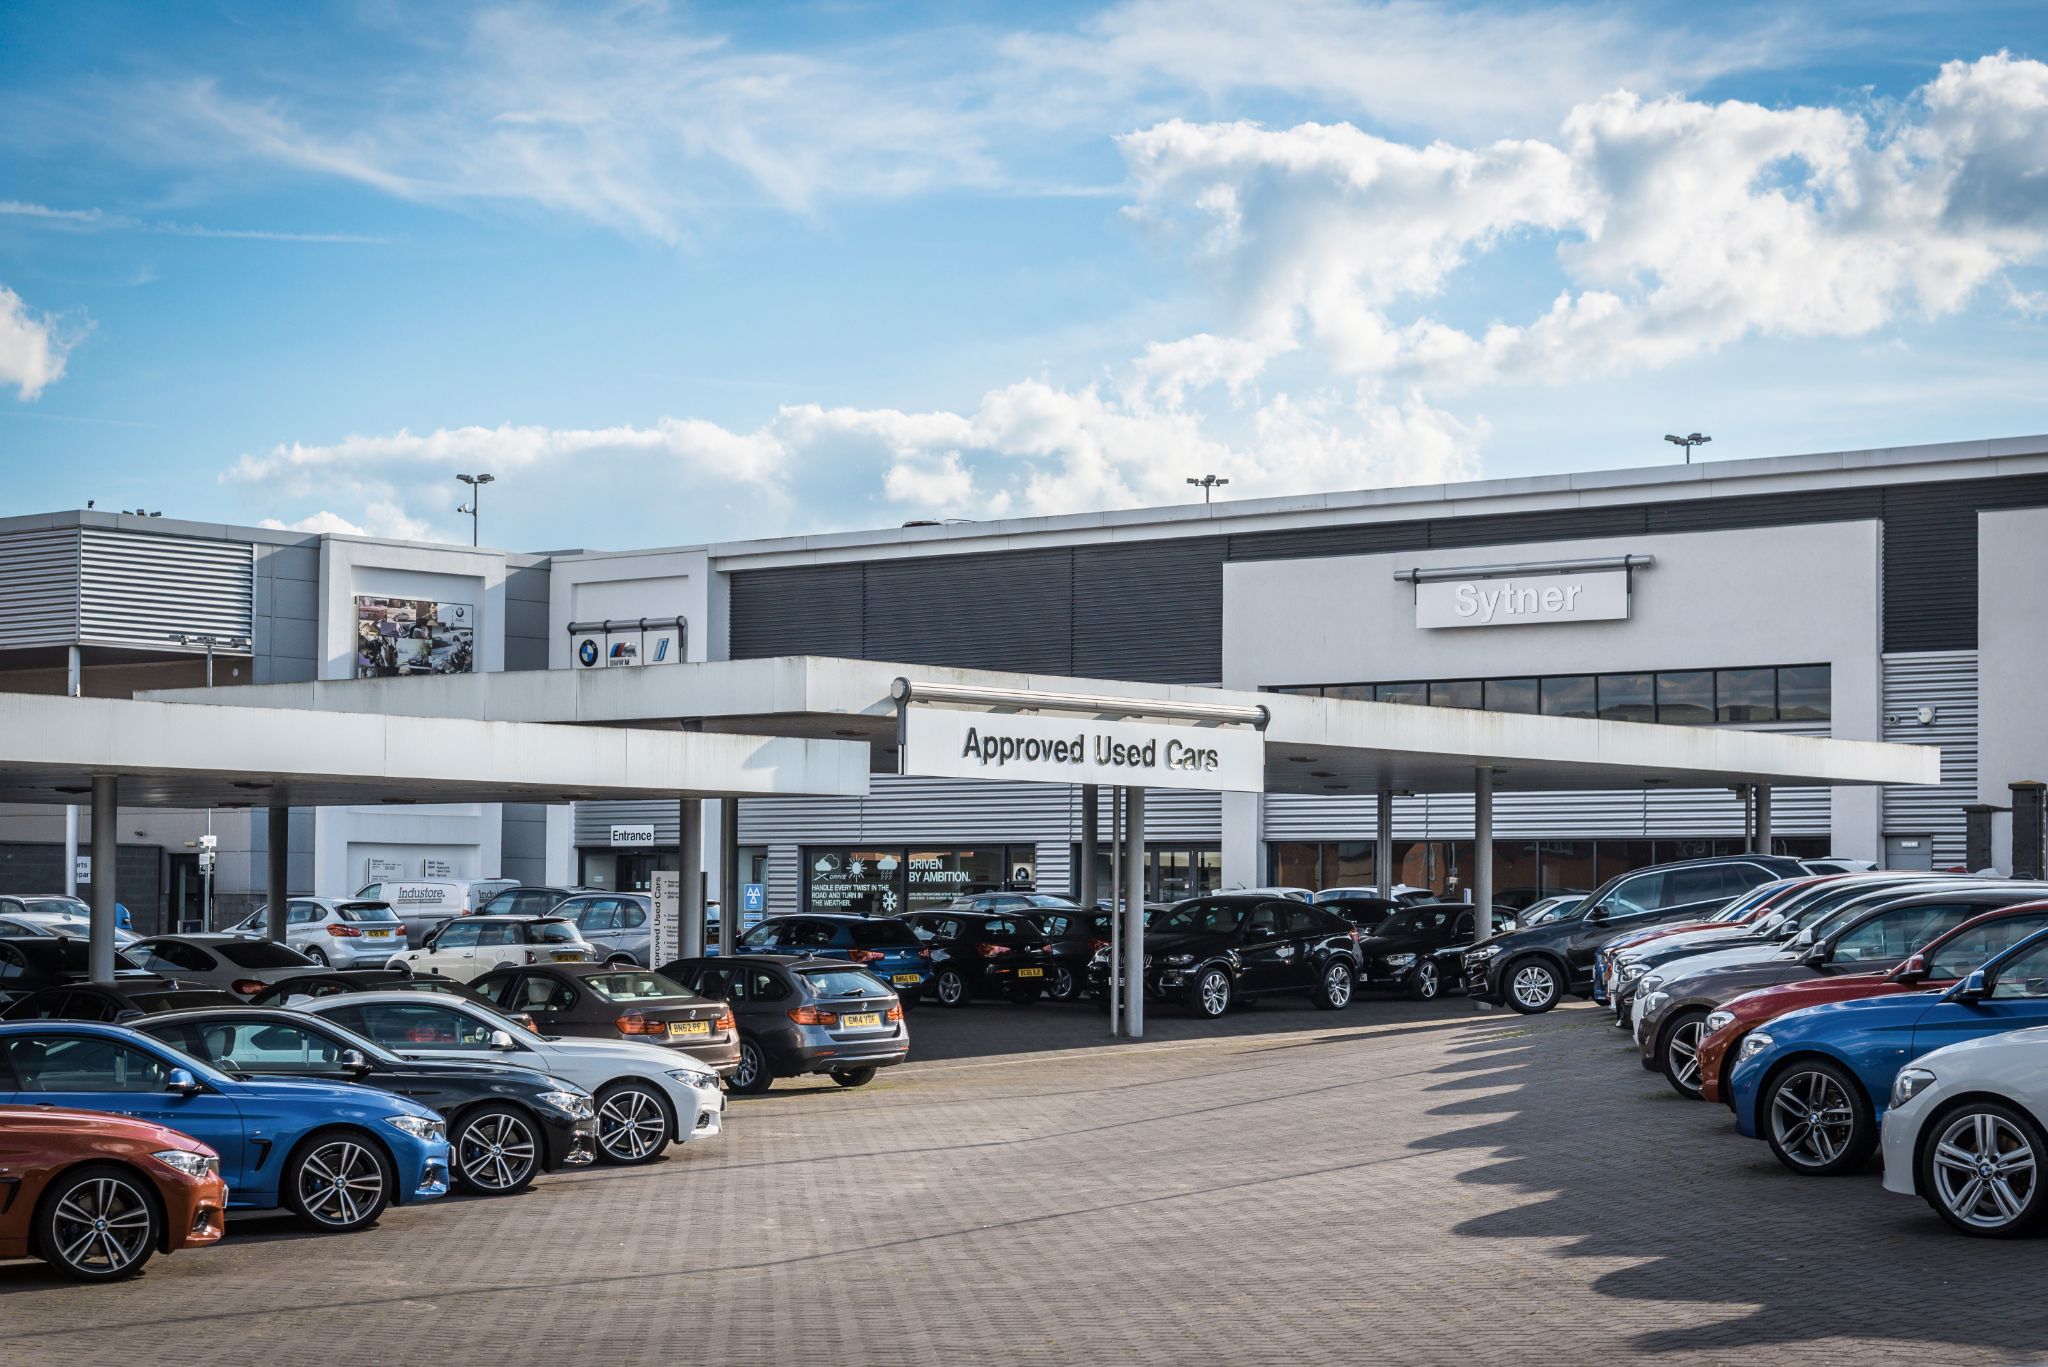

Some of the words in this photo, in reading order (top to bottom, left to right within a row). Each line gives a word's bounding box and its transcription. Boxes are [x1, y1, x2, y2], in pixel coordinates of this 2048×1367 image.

[1455, 583, 1583, 623] Sytner
[962, 727, 1085, 768] Approved
[1095, 733, 1157, 768] Used
[1167, 738, 1220, 771] Cars
[612, 830, 652, 841] Entrance
[908, 858, 943, 870] DRIVEN
[908, 871, 921, 883] BY
[923, 871, 971, 883] AMBITION.
[811, 899, 823, 907] THE
[823, 899, 852, 907] WEATHER.
[673, 1022, 692, 1033] BN62
